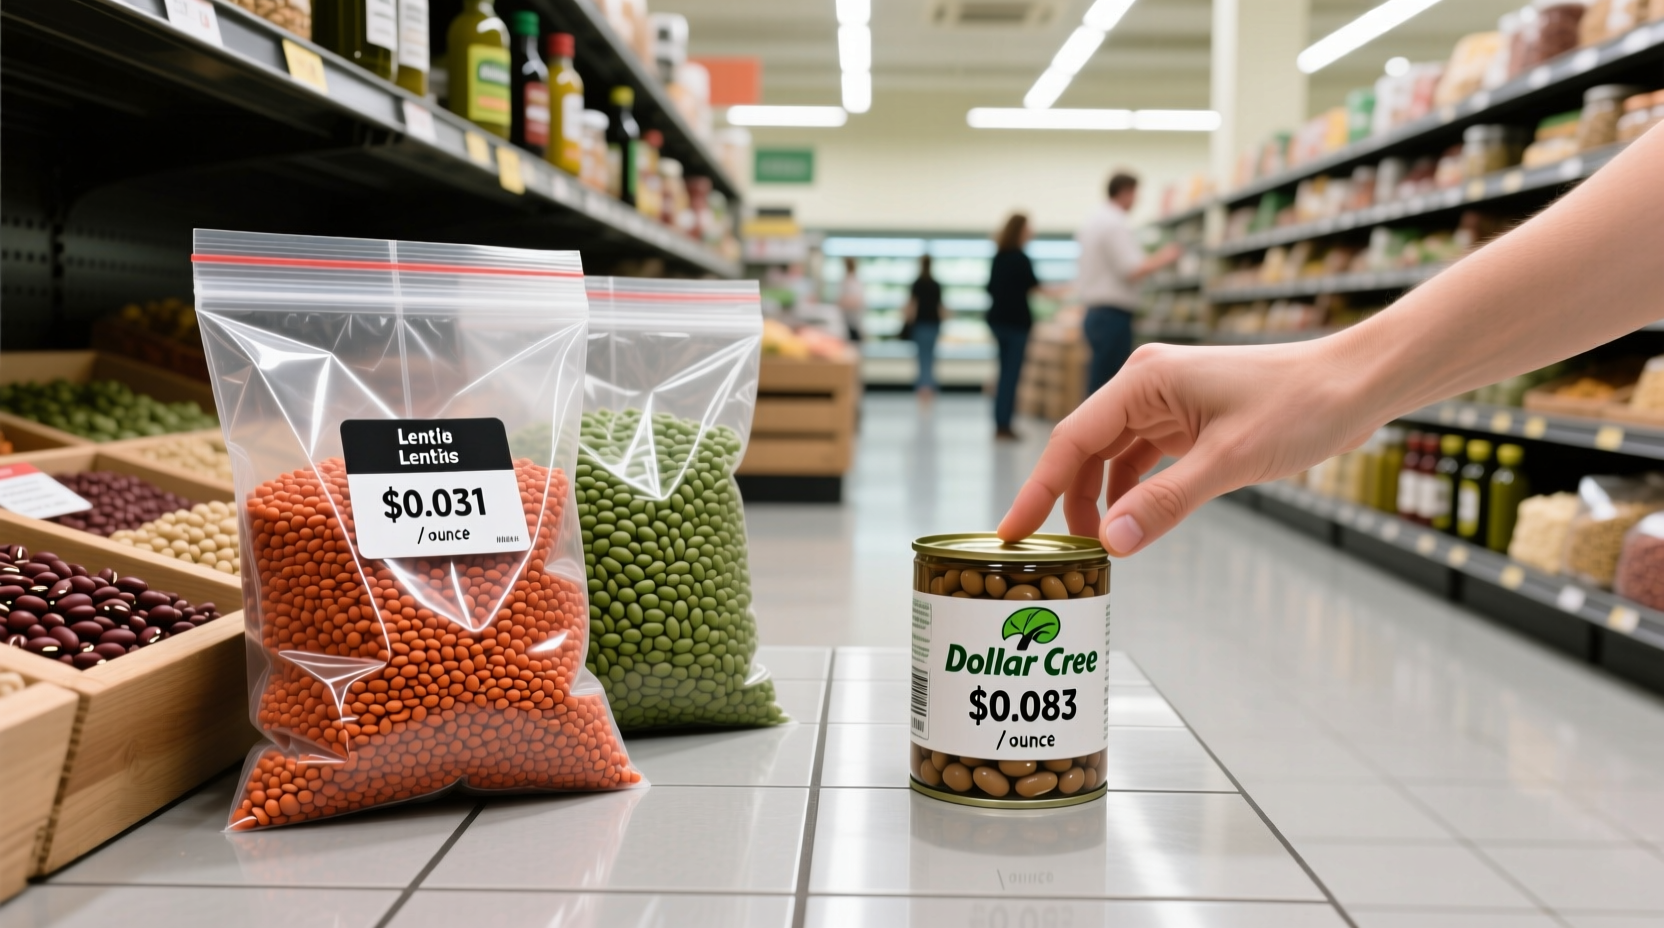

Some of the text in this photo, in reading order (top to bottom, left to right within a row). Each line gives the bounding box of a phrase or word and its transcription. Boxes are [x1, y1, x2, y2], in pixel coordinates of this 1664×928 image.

[383, 486, 486, 523] $0.031
[418, 527, 470, 544] / ounce
[945, 644, 1097, 676] Dollar Cree
[969, 685, 1076, 726] $0.083
[996, 730, 1055, 750] / ounce
